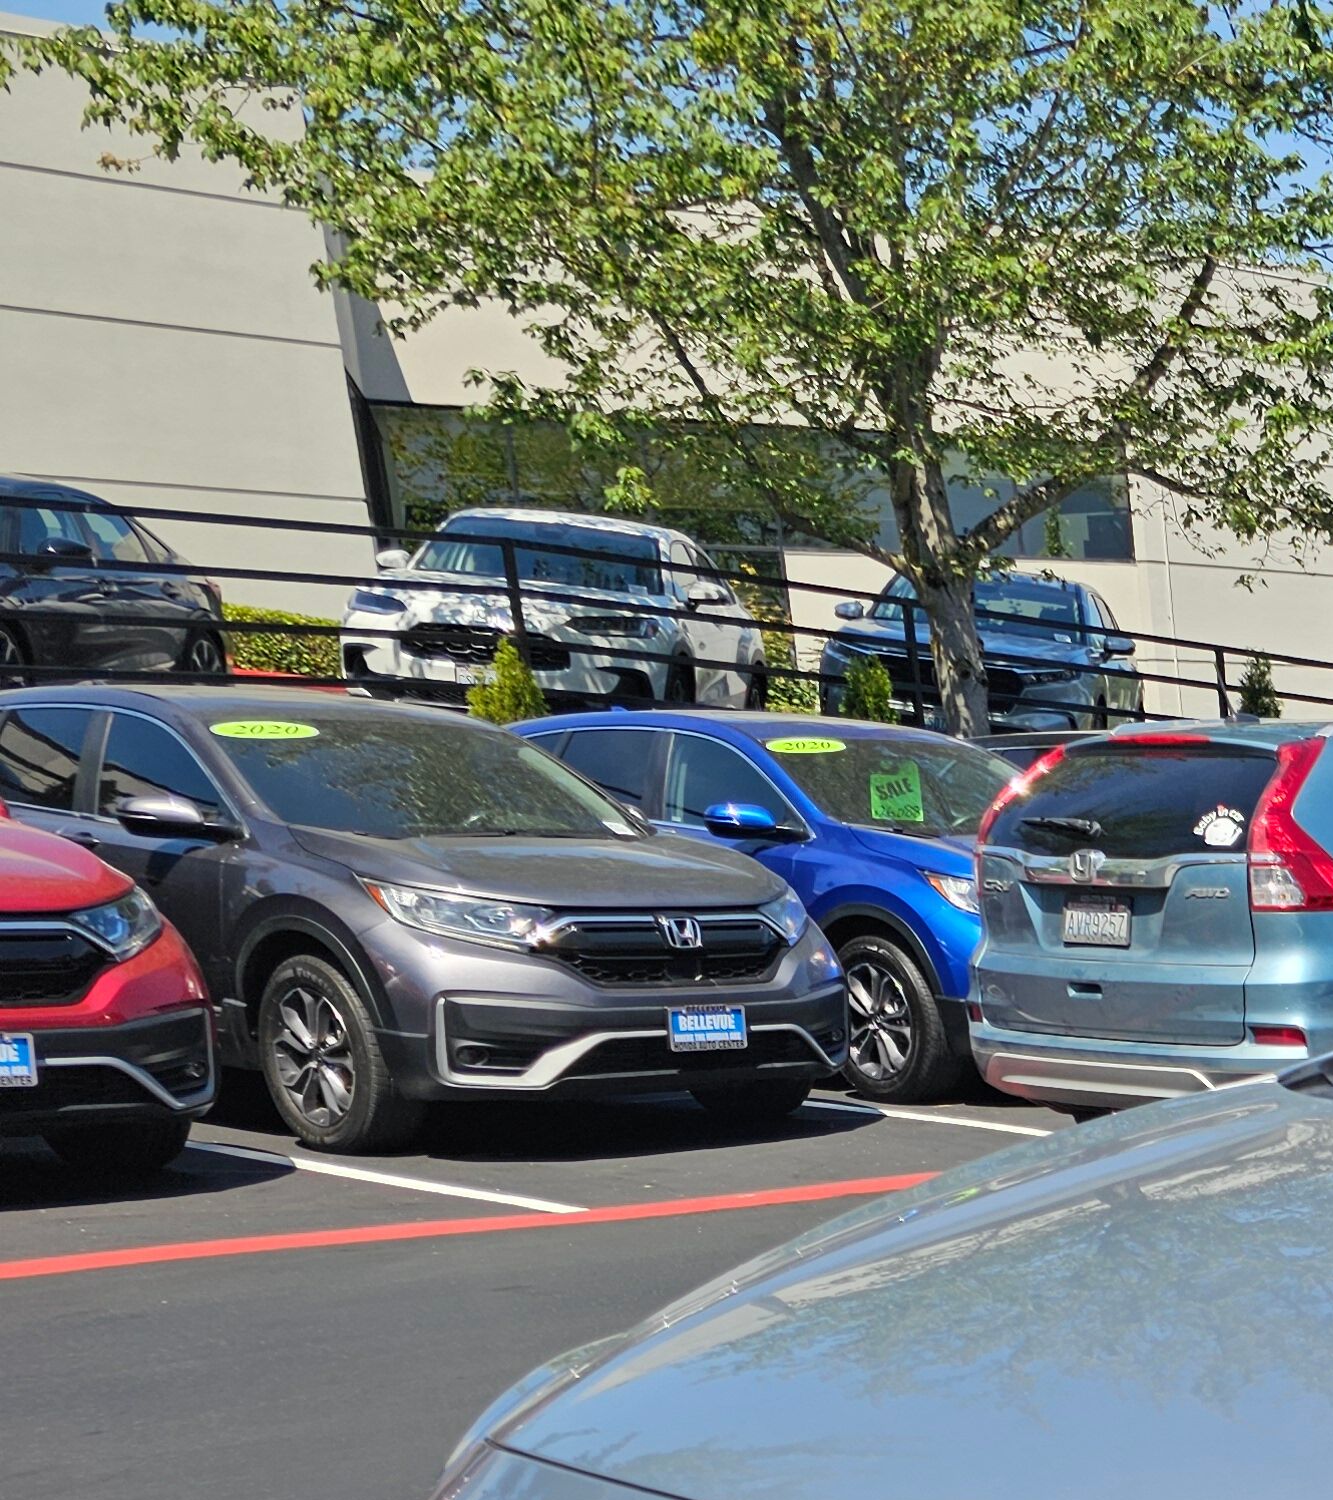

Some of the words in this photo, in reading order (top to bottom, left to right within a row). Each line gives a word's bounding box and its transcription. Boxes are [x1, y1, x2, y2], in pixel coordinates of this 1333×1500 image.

[233, 724, 299, 735] 2020
[784, 741, 831, 751] 2020
[875, 778, 914, 801] SALE
[1184, 887, 1230, 900] AWD
[1067, 911, 1126, 941] AVR9257
[678, 1014, 736, 1032] BELLEVUE
[718, 1039, 745, 1049] CENTER
